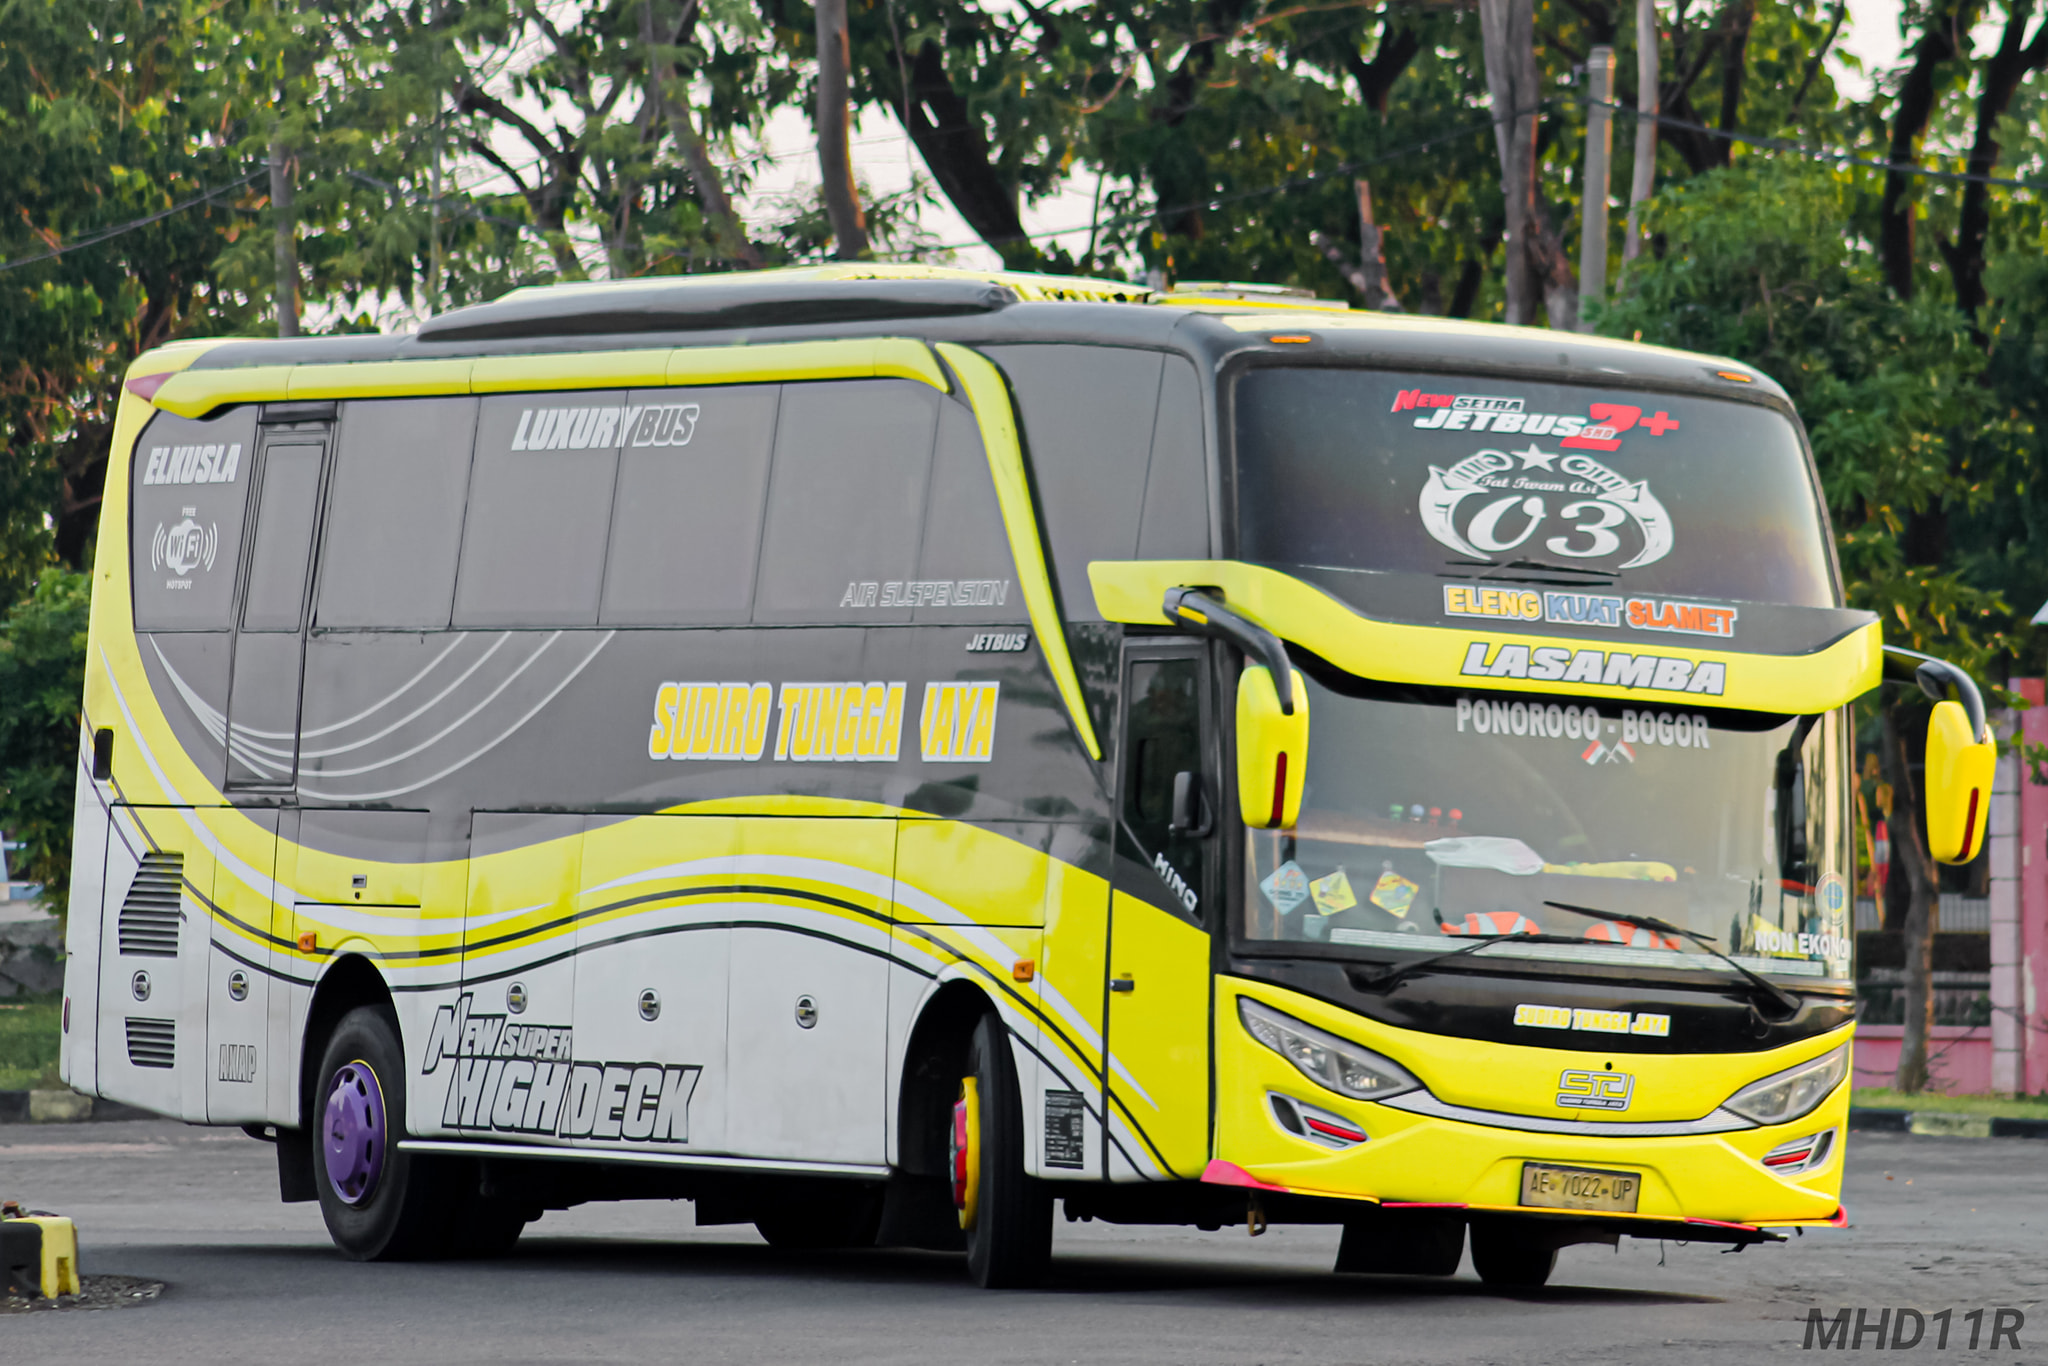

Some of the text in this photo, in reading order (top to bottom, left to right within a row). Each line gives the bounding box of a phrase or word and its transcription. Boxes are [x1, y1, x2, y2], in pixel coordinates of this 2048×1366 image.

[1391, 389, 1525, 413] NEW SETRA
[1413, 408, 1588, 437] JETBUS
[143, 443, 242, 485] ELKUSLA
[1480, 476, 1509, 489] Tat
[1512, 478, 1565, 492] Twam
[182, 507, 196, 517] FREE
[1467, 496, 1626, 558] 03
[166, 579, 192, 590] HOTSPOT
[840, 580, 1009, 608] AIR SUSPENSION
[1444, 585, 1738, 638] ELENG KUAT SLAMET
[965, 632, 1030, 653] JETBUS
[1460, 641, 1727, 696] LASAMBA
[648, 681, 773, 761] SUDIRO
[774, 681, 907, 762] TUNGGA
[1456, 699, 1600, 741] PONOROGO
[1622, 709, 1710, 749] BOGOR
[1154, 852, 1198, 912] HINO
[1754, 930, 1795, 953] NON
[1513, 1003, 1671, 1037] SUDIRO TUNGGA JAYA
[501, 1023, 573, 1062] SUPER
[441, 1056, 704, 1144] HIGH DECK
